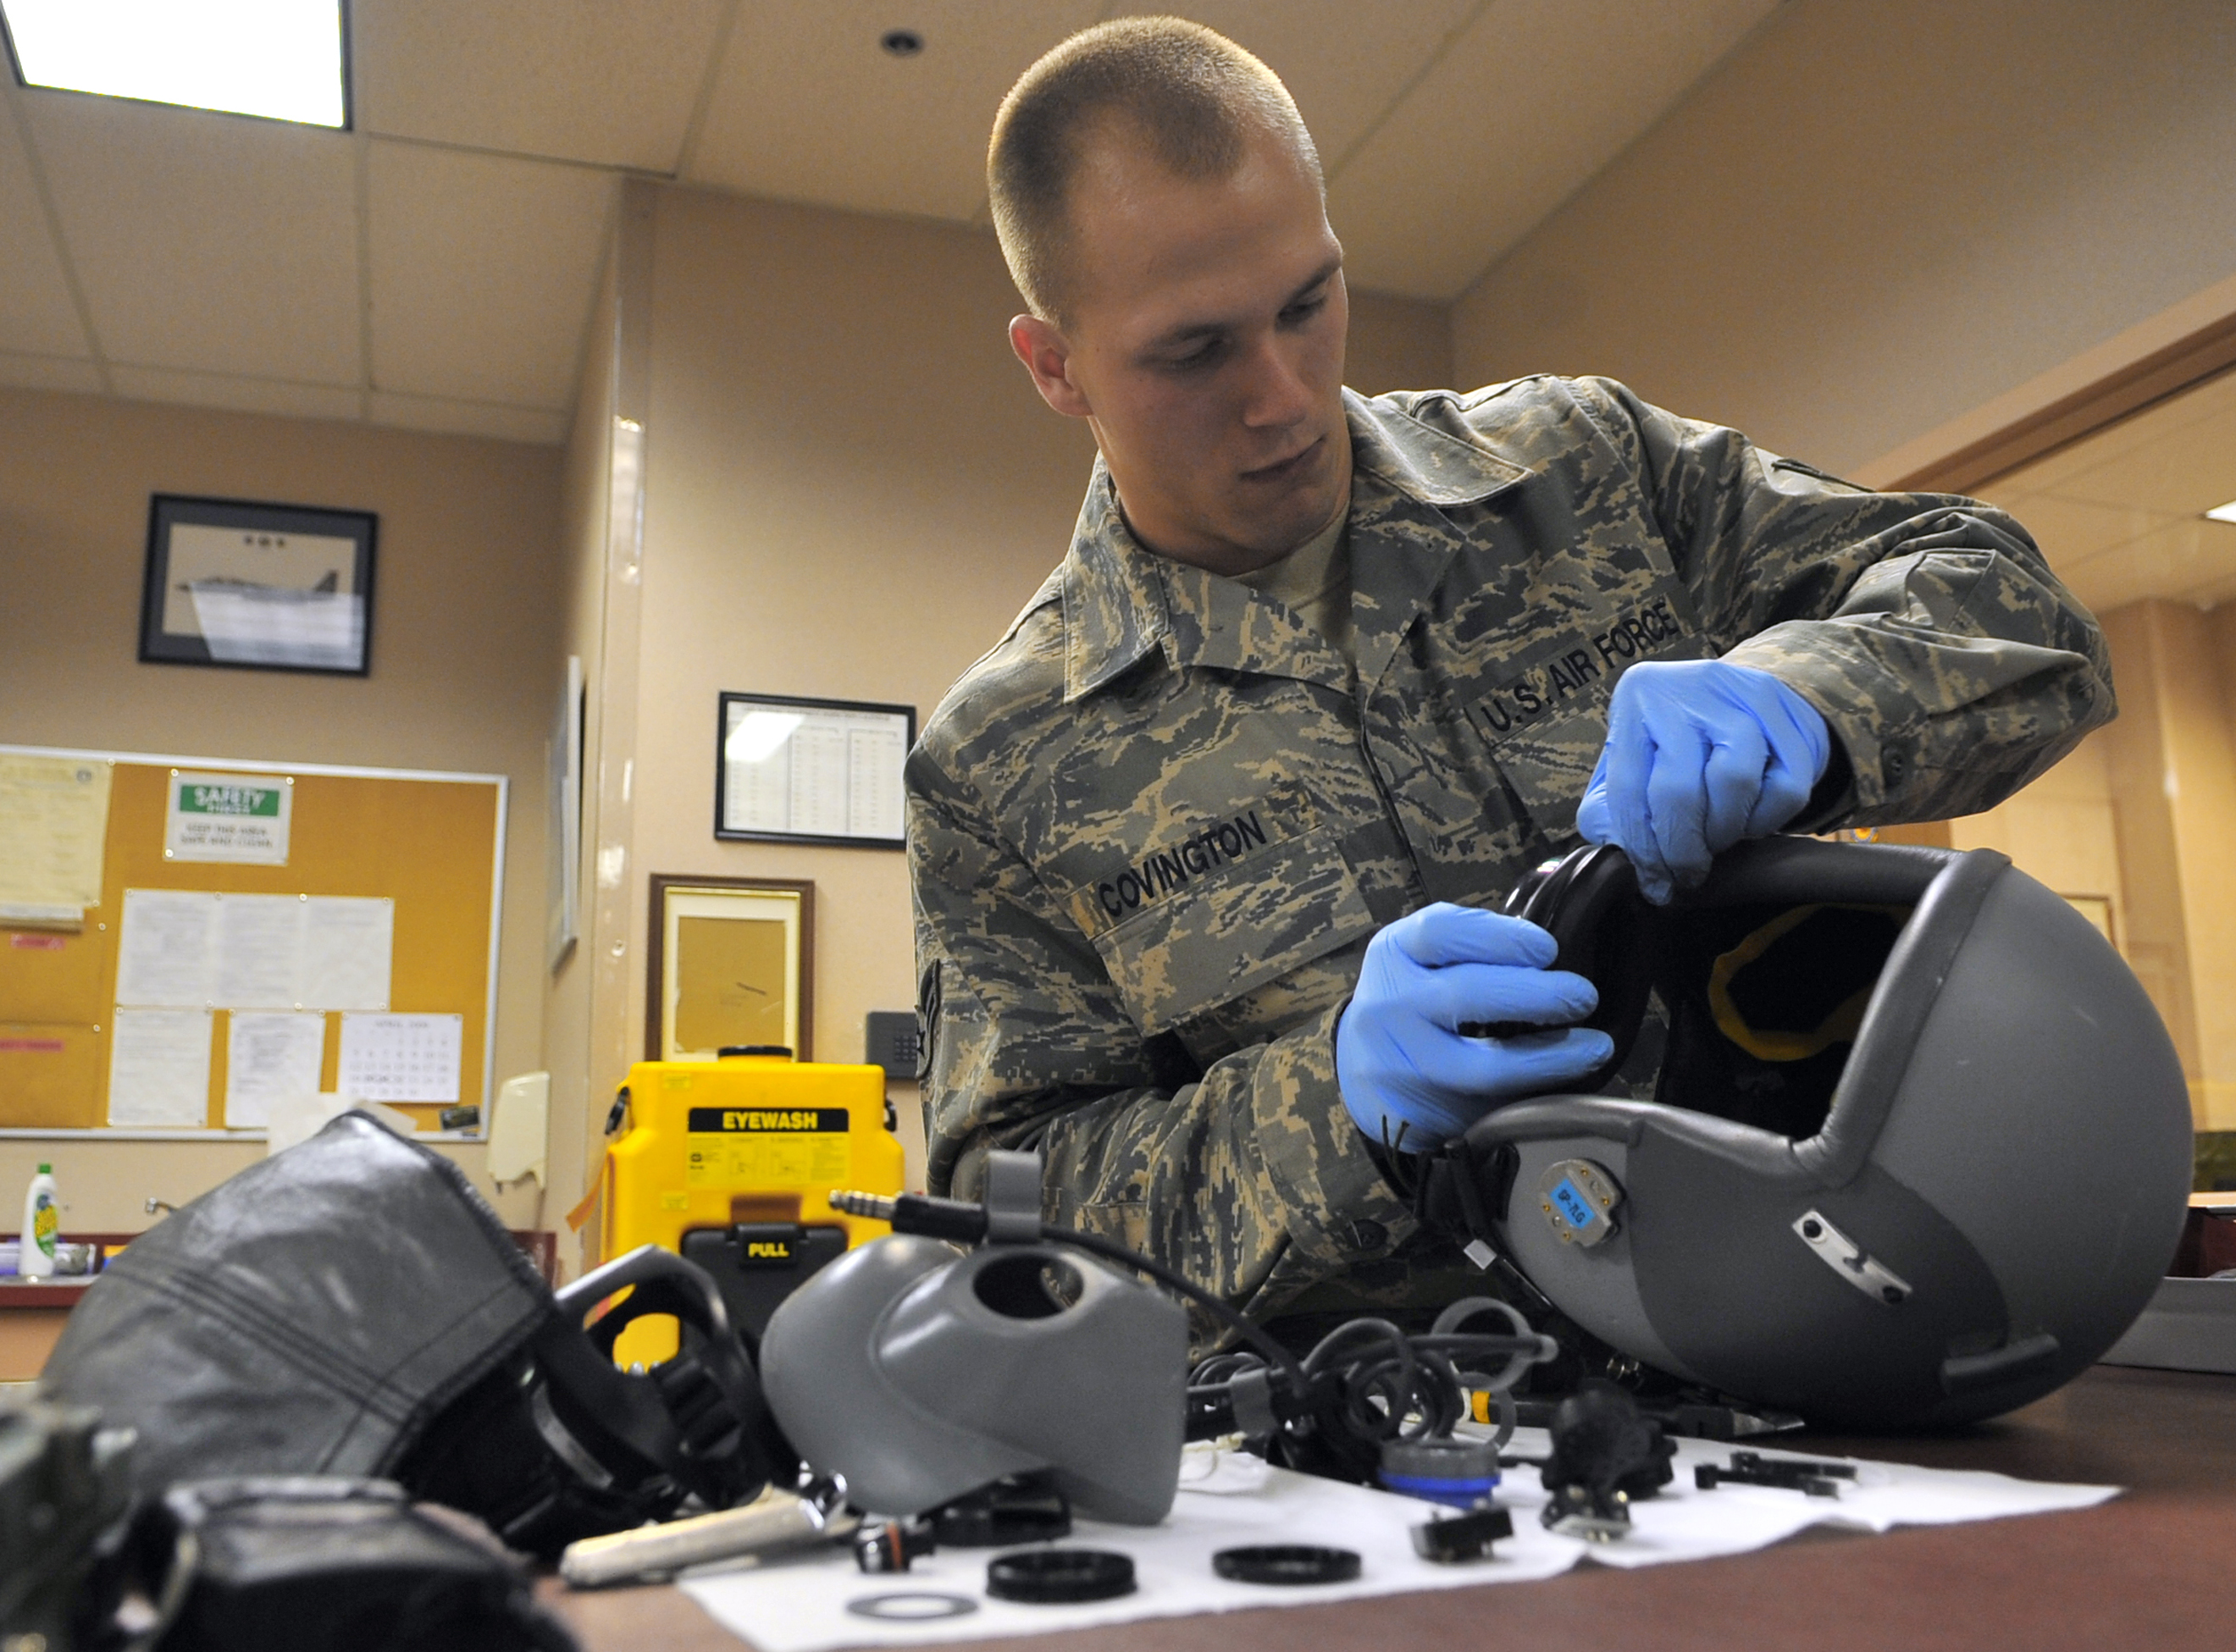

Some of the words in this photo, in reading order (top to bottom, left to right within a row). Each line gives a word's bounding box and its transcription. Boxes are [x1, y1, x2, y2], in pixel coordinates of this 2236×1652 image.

[1481, 682, 1554, 732] U.S.
[1548, 648, 1601, 699] AIR
[1592, 601, 1680, 669] FORCE
[193, 785, 267, 810] SAFETY
[1098, 809, 1268, 917] COVINGTON
[722, 1111, 819, 1130] EYEWASH
[748, 1242, 789, 1258] PULL
